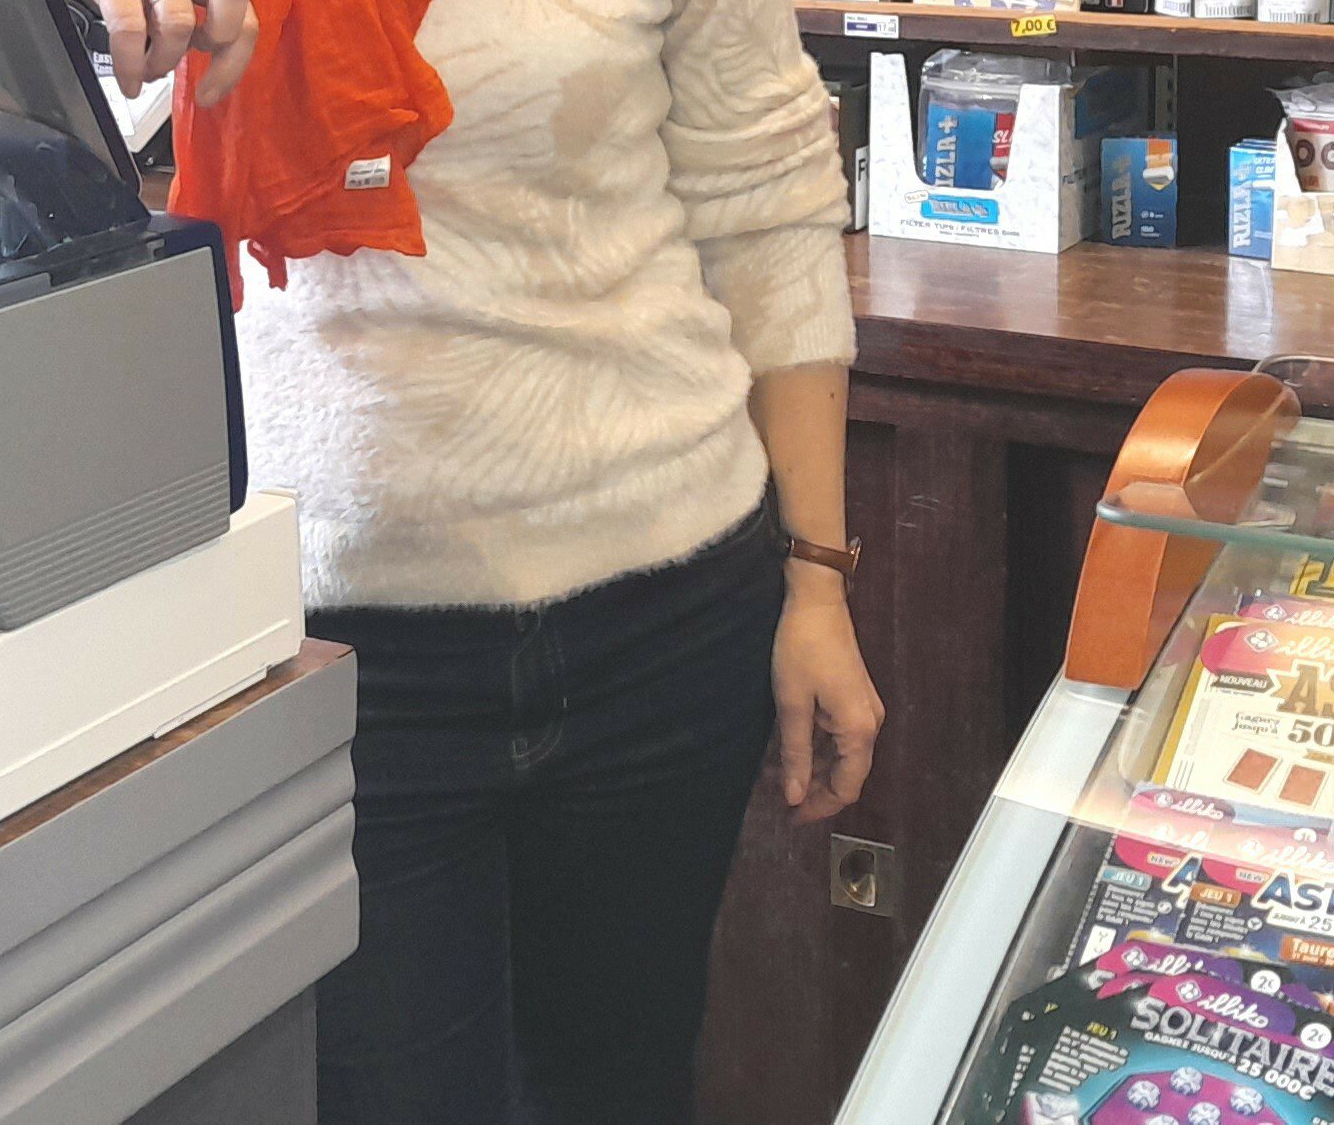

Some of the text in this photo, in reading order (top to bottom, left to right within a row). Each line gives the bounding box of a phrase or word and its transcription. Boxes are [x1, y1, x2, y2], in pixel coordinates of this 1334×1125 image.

[1013, 18, 1056, 36] 7,00 €
[1197, 993, 1269, 1028] illiko
[1087, 1021, 1109, 1037] JEU
[1237, 1058, 1262, 1077] 25
